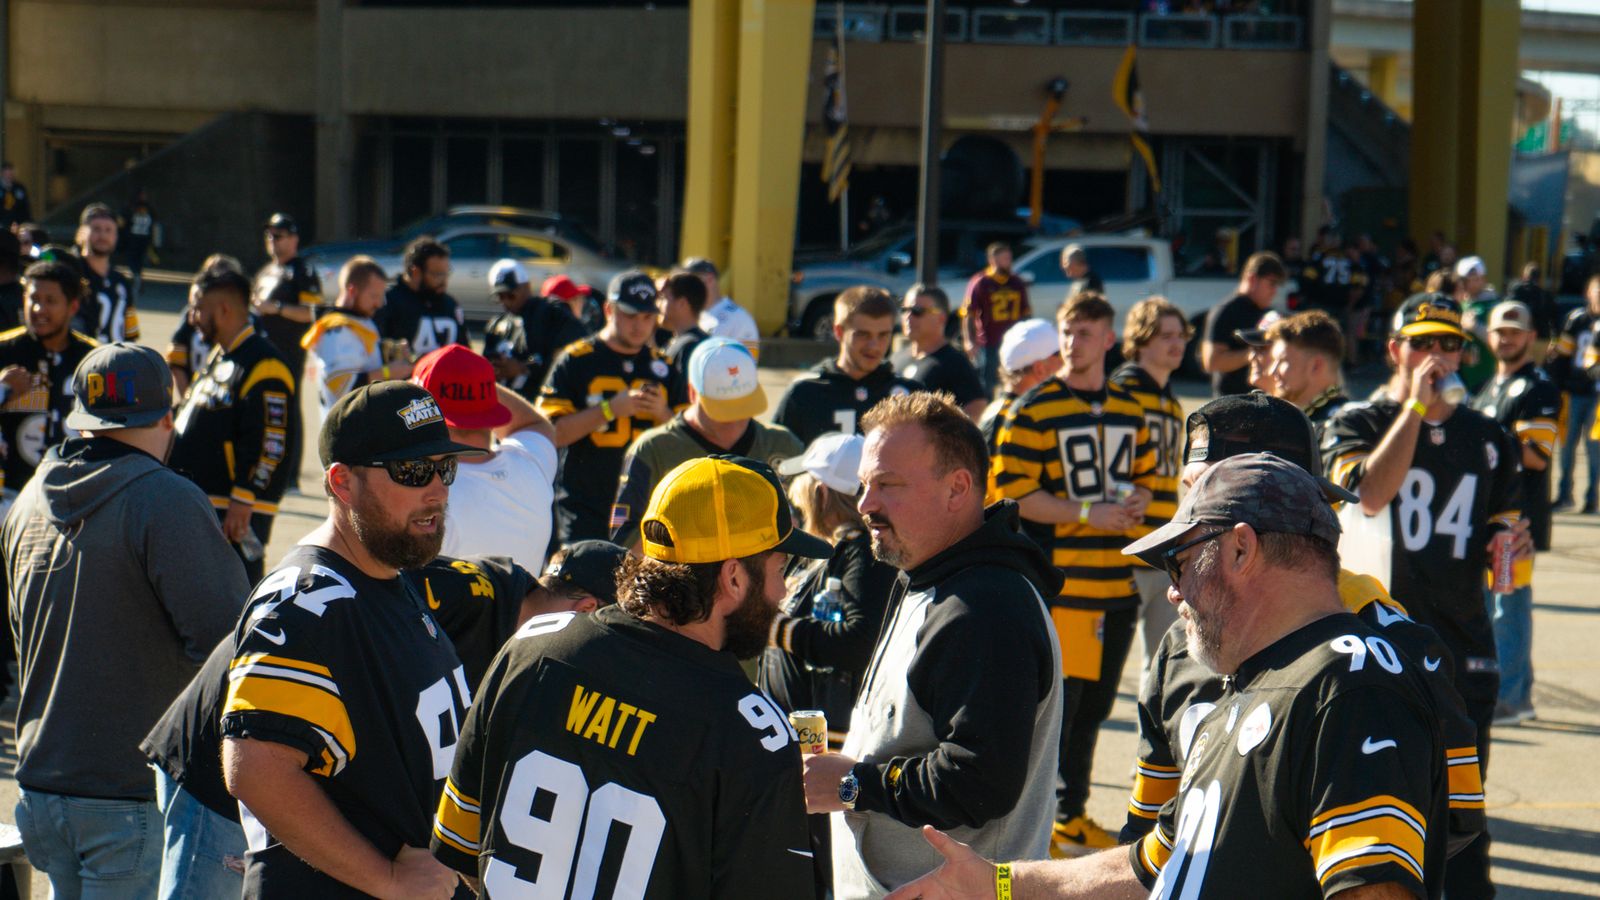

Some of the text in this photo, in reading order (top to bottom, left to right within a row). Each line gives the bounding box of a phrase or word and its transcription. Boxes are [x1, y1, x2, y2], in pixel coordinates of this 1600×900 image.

[991, 290, 1021, 321] 27
[440, 381, 494, 401] KILL IT
[1064, 433, 1135, 498] 84
[1398, 466, 1479, 560] 84
[1330, 634, 1403, 675] 90
[565, 684, 657, 757] WATT
[484, 749, 667, 900] 90
